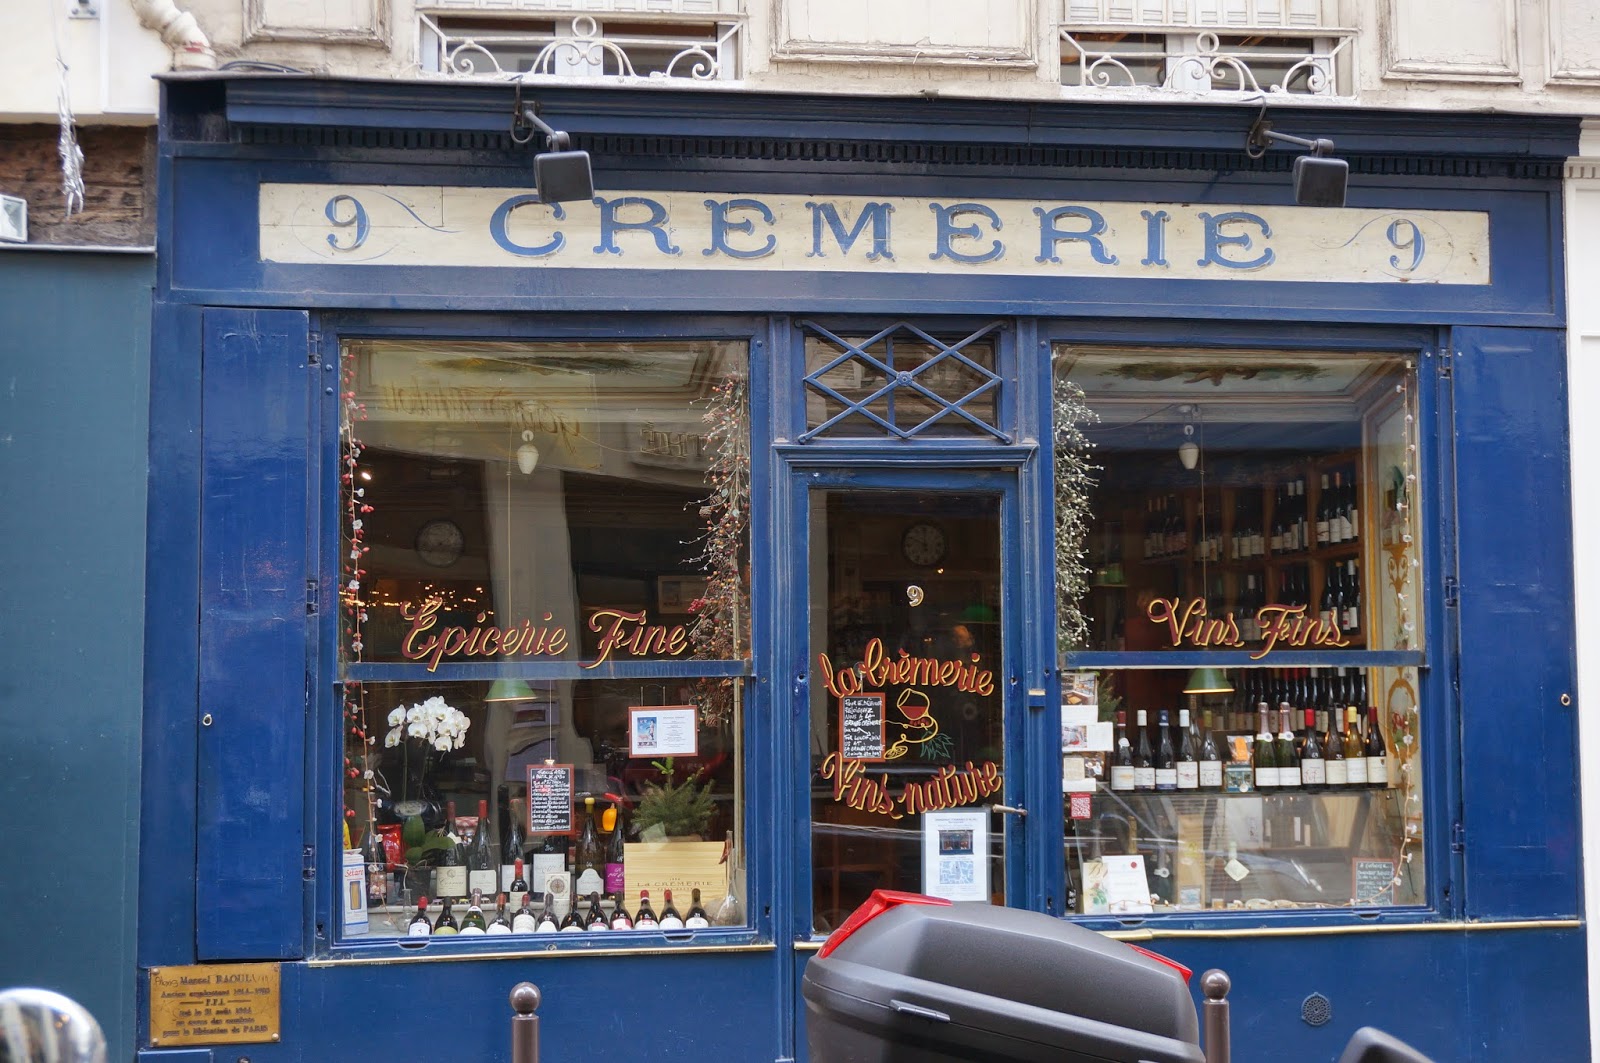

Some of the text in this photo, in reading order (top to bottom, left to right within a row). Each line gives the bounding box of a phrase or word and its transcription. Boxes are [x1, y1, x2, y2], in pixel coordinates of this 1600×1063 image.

[325, 193, 1426, 273] 9 CREMERIE 9
[906, 585, 924, 607] 9
[577, 608, 688, 669] Fine
[1147, 597, 1350, 660] Vins Fins
[820, 751, 1002, 820] Vins nature
[180, 975, 210, 985] Marcel
[243, 1024, 268, 1033] PARIS
